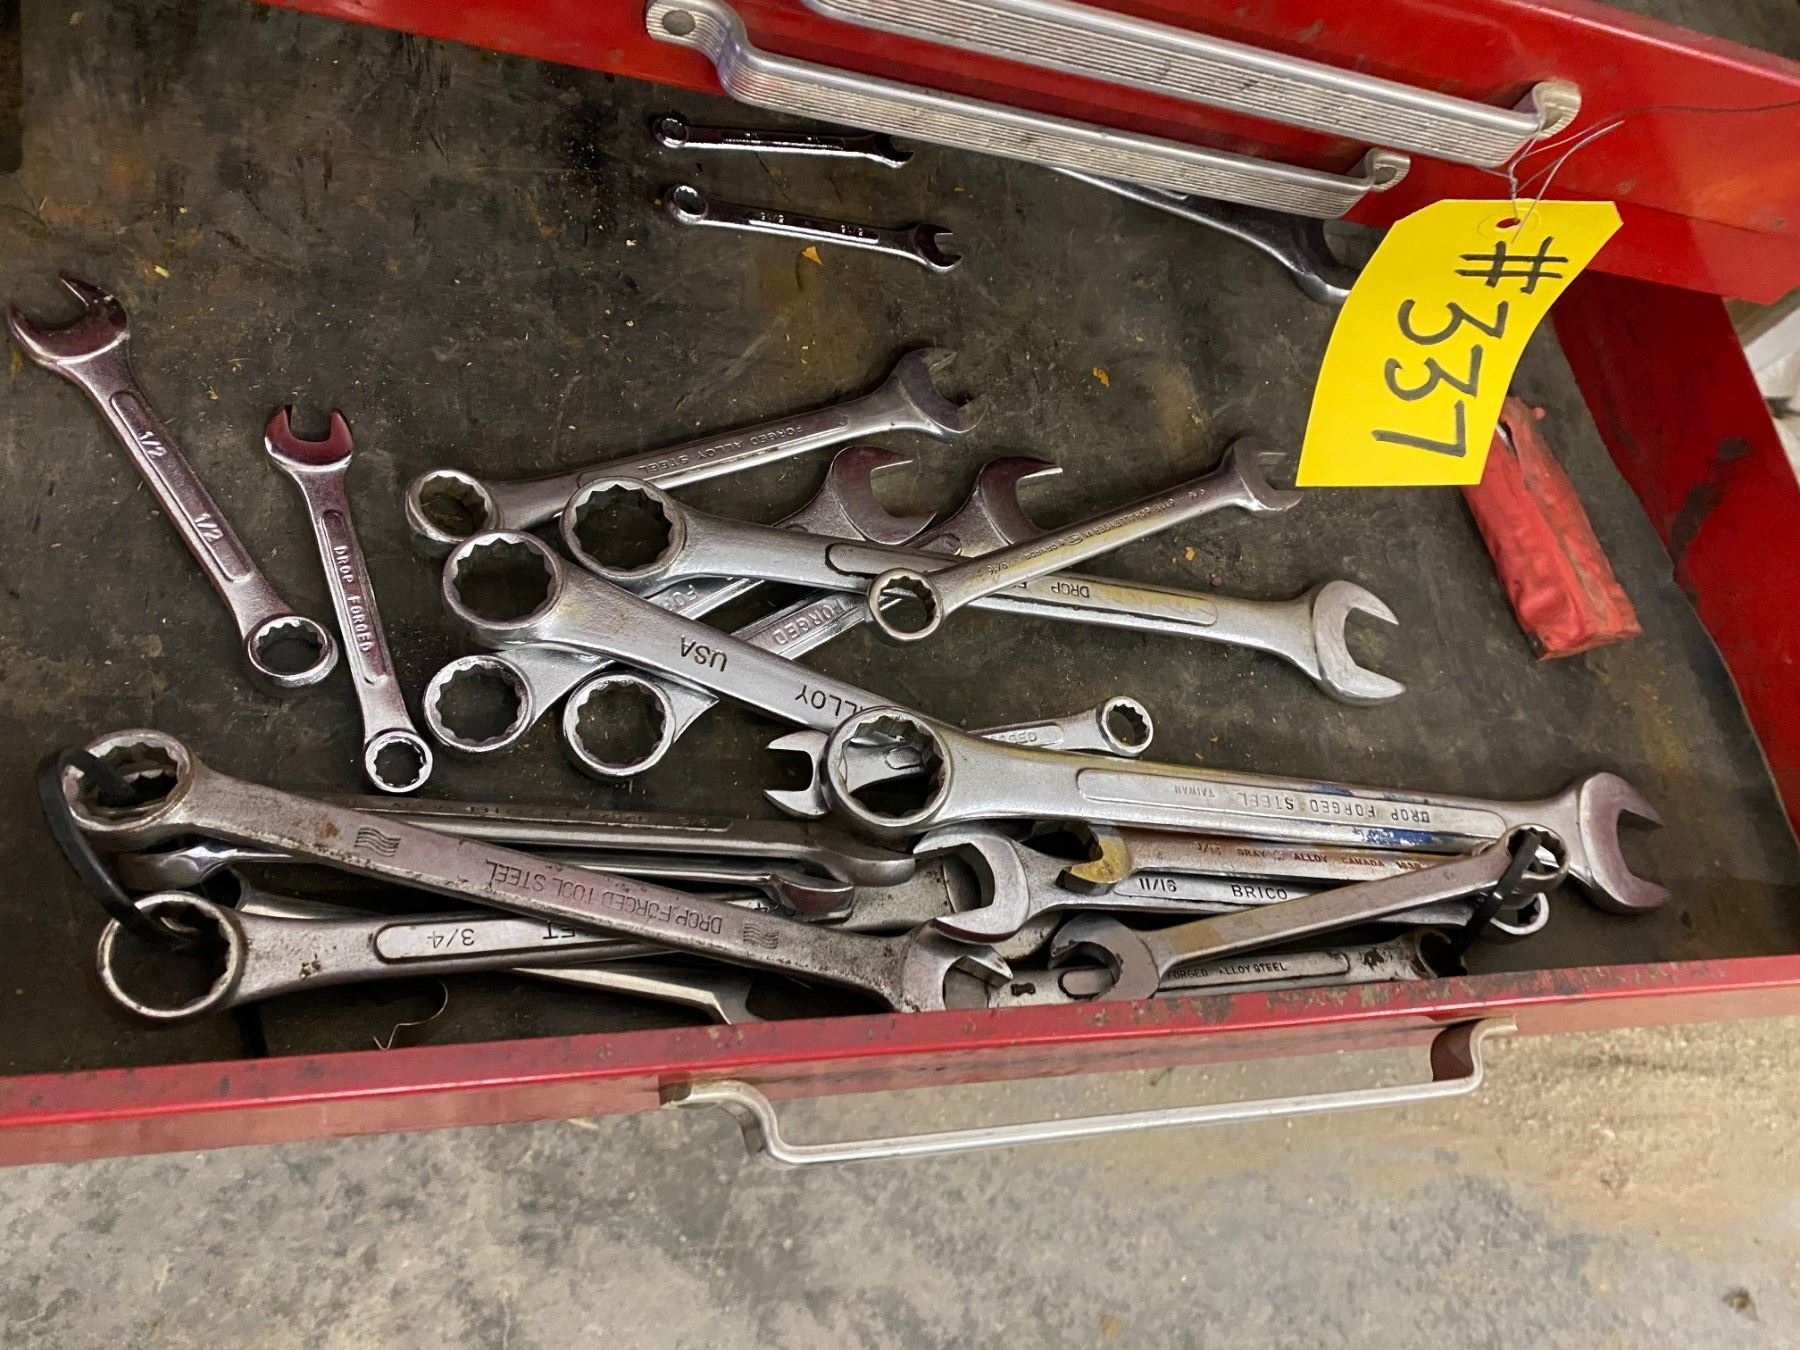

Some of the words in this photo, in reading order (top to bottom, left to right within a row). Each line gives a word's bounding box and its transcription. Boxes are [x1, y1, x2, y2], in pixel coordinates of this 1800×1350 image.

[1371, 235, 1569, 458] #337
[138, 431, 167, 460] 1/2
[696, 440, 744, 459] ALLOY
[637, 454, 689, 474] STEEL
[193, 512, 223, 543] 1/2
[334, 545, 355, 584] DROP
[1051, 582, 1090, 598] DROP
[772, 599, 844, 646] FORGED
[680, 634, 729, 672] USA
[795, 684, 866, 719] LLOY
[1173, 783, 1215, 798] TAIWAN
[1236, 791, 1294, 811] STEEL
[1308, 798, 1375, 818] FORGED
[1390, 807, 1430, 824] DROP
[1293, 852, 1327, 862] ALLOY
[485, 860, 547, 892] STEEL
[1138, 877, 1177, 892] 11/16
[1230, 884, 1287, 900] BRICO
[675, 907, 723, 935] DROP
[427, 928, 474, 949] 3/4
[1166, 967, 1208, 980] FORGED
[1252, 961, 1287, 973] STEEL
